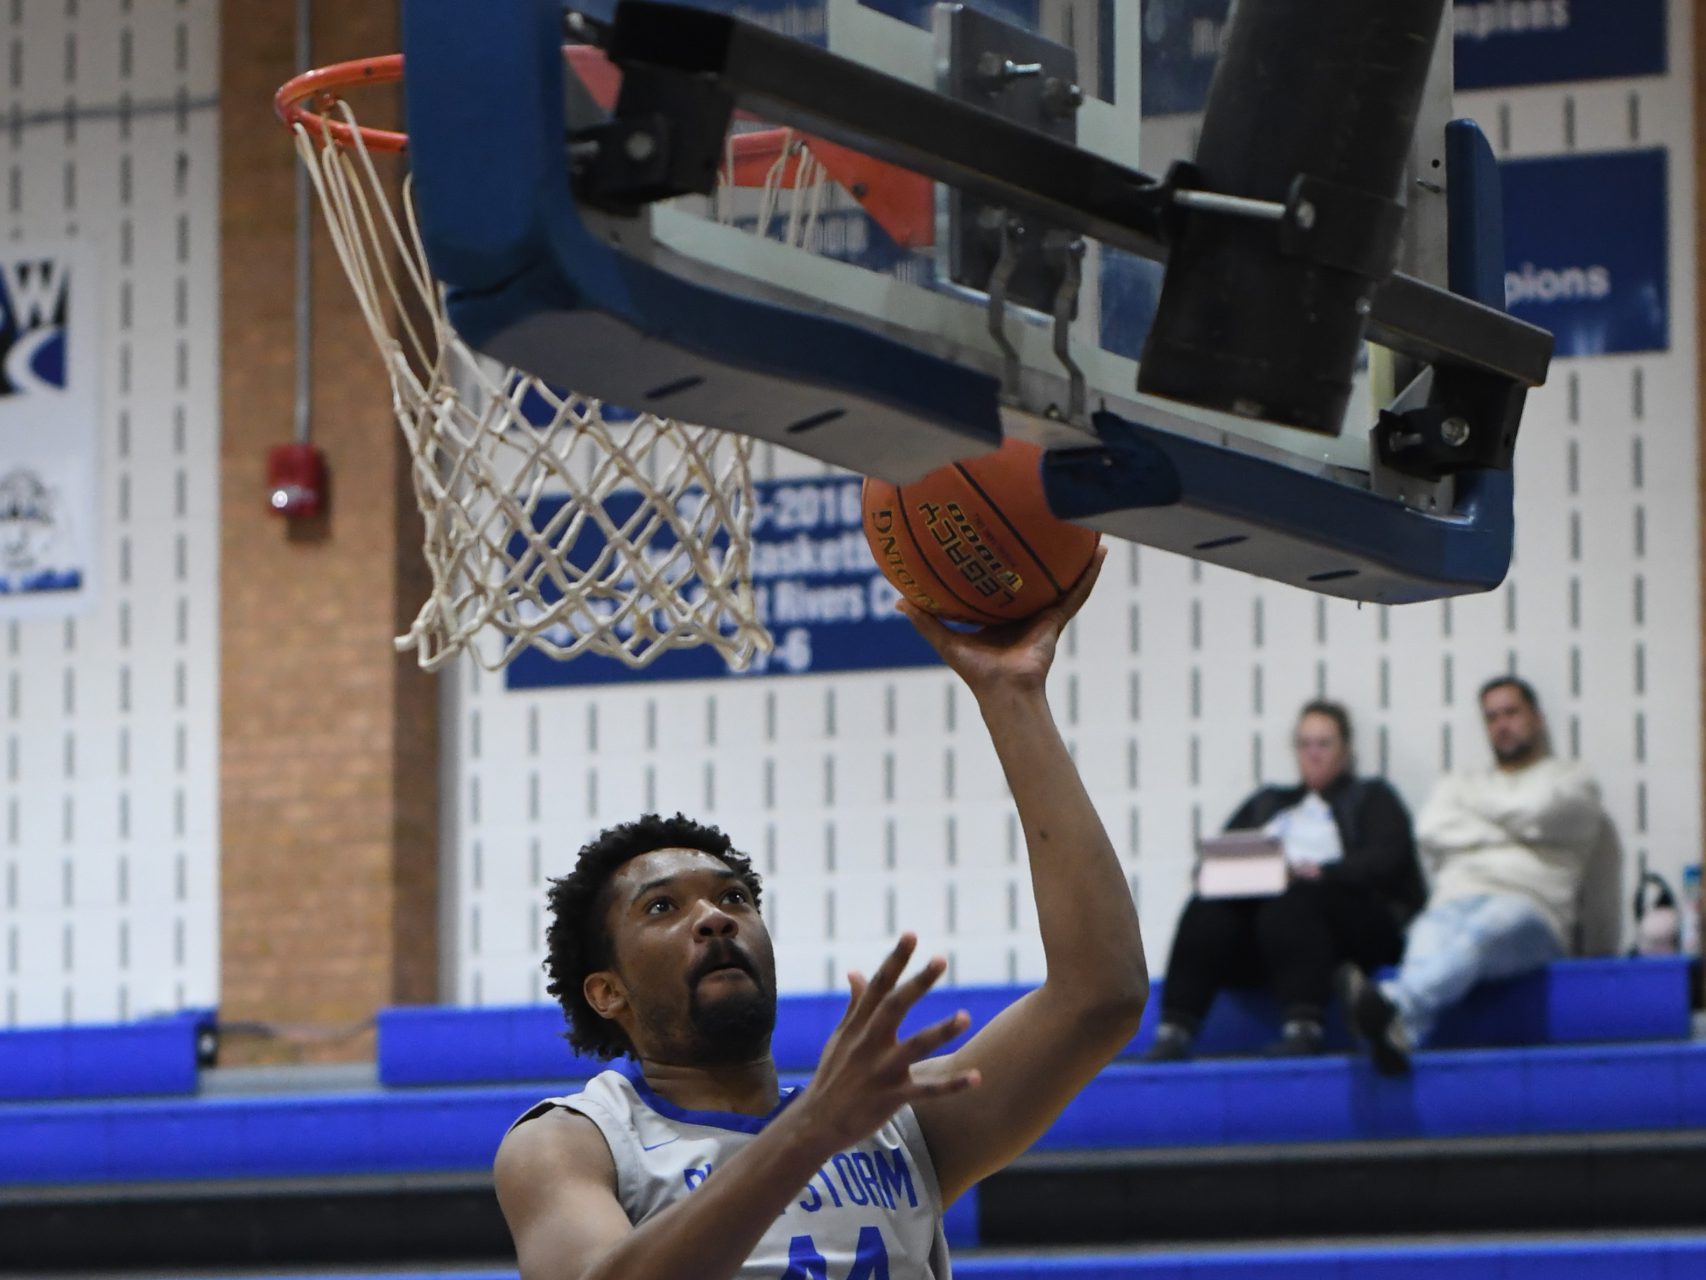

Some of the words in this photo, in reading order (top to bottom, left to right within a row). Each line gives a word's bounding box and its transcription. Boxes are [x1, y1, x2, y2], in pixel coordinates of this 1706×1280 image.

[1504, 263, 1610, 306] pions
[919, 502, 1014, 604] LEGACY
[946, 502, 1003, 571] 1000
